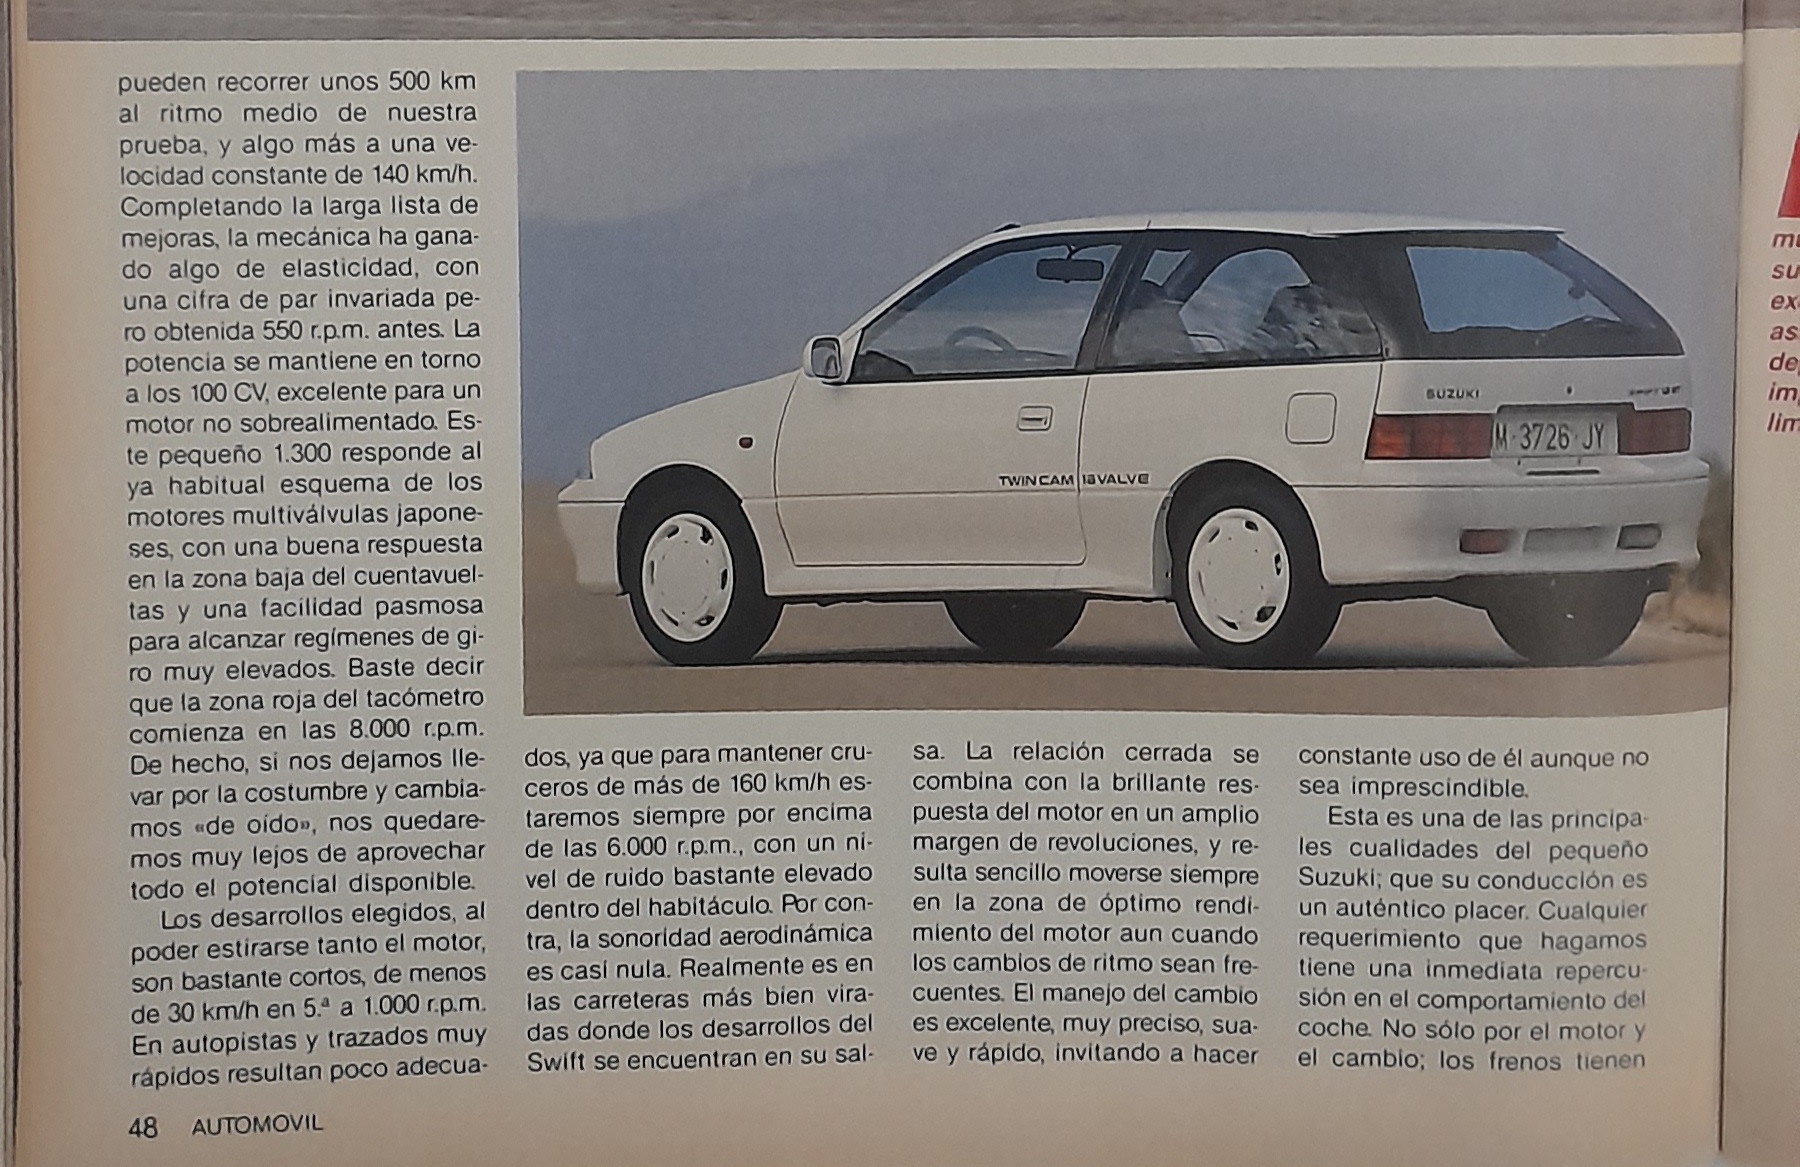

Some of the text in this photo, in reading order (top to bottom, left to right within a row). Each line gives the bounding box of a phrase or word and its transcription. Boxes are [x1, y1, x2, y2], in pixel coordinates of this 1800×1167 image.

[118, 70, 476, 96] pueden recorrer unos 500 km
[121, 195, 478, 221] Completando la larga lista de
[124, 287, 480, 314] una cifra de par invariada pe-
[125, 350, 481, 376] potencia se mantiene en torno
[1426, 388, 1479, 400] SUZUKI
[128, 503, 483, 527] motores multiválvulas japone-
[129, 596, 484, 624] tas y una facilidad pasmosa
[129, 687, 484, 717] que la zona roja del tacómetro
[525, 744, 872, 771] dos, ya que para mantener cru-
[913, 740, 1259, 764] sa. La relación cerrada se
[1299, 747, 1649, 772] constante uso de él aunque no
[130, 778, 486, 810] var por la costumbre y cambia-
[526, 802, 872, 828] taremos siempre por encima
[913, 801, 1259, 828] puesta del motor en un amplio
[1329, 805, 1647, 833] Esta es una de las principa-
[131, 840, 486, 871] mos muy lejos de aprovechar
[1299, 836, 1648, 864] les cualidades del pequeño
[526, 862, 873, 889] vel de ruido bastante elevado
[914, 862, 1259, 888] sulta sencillo moverse siempre
[527, 922, 873, 953] tra, la sonoridad aerodinámica
[913, 922, 1258, 945] miento del motor aun cuando
[1299, 928, 1647, 955] requerimiento que hagamos
[131, 933, 486, 966] poder estirarse tanto el motor,
[1299, 957, 1646, 984] tiene una inmediata repercu-
[527, 983, 874, 1011] las carreteras más bien vira-
[913, 982, 1258, 1006] cuentes. El manejo del cambio
[1298, 1047, 1645, 1071] el cambio; los frenos tienen
[128, 1114, 324, 1139] 48 AUTOMOVIL
